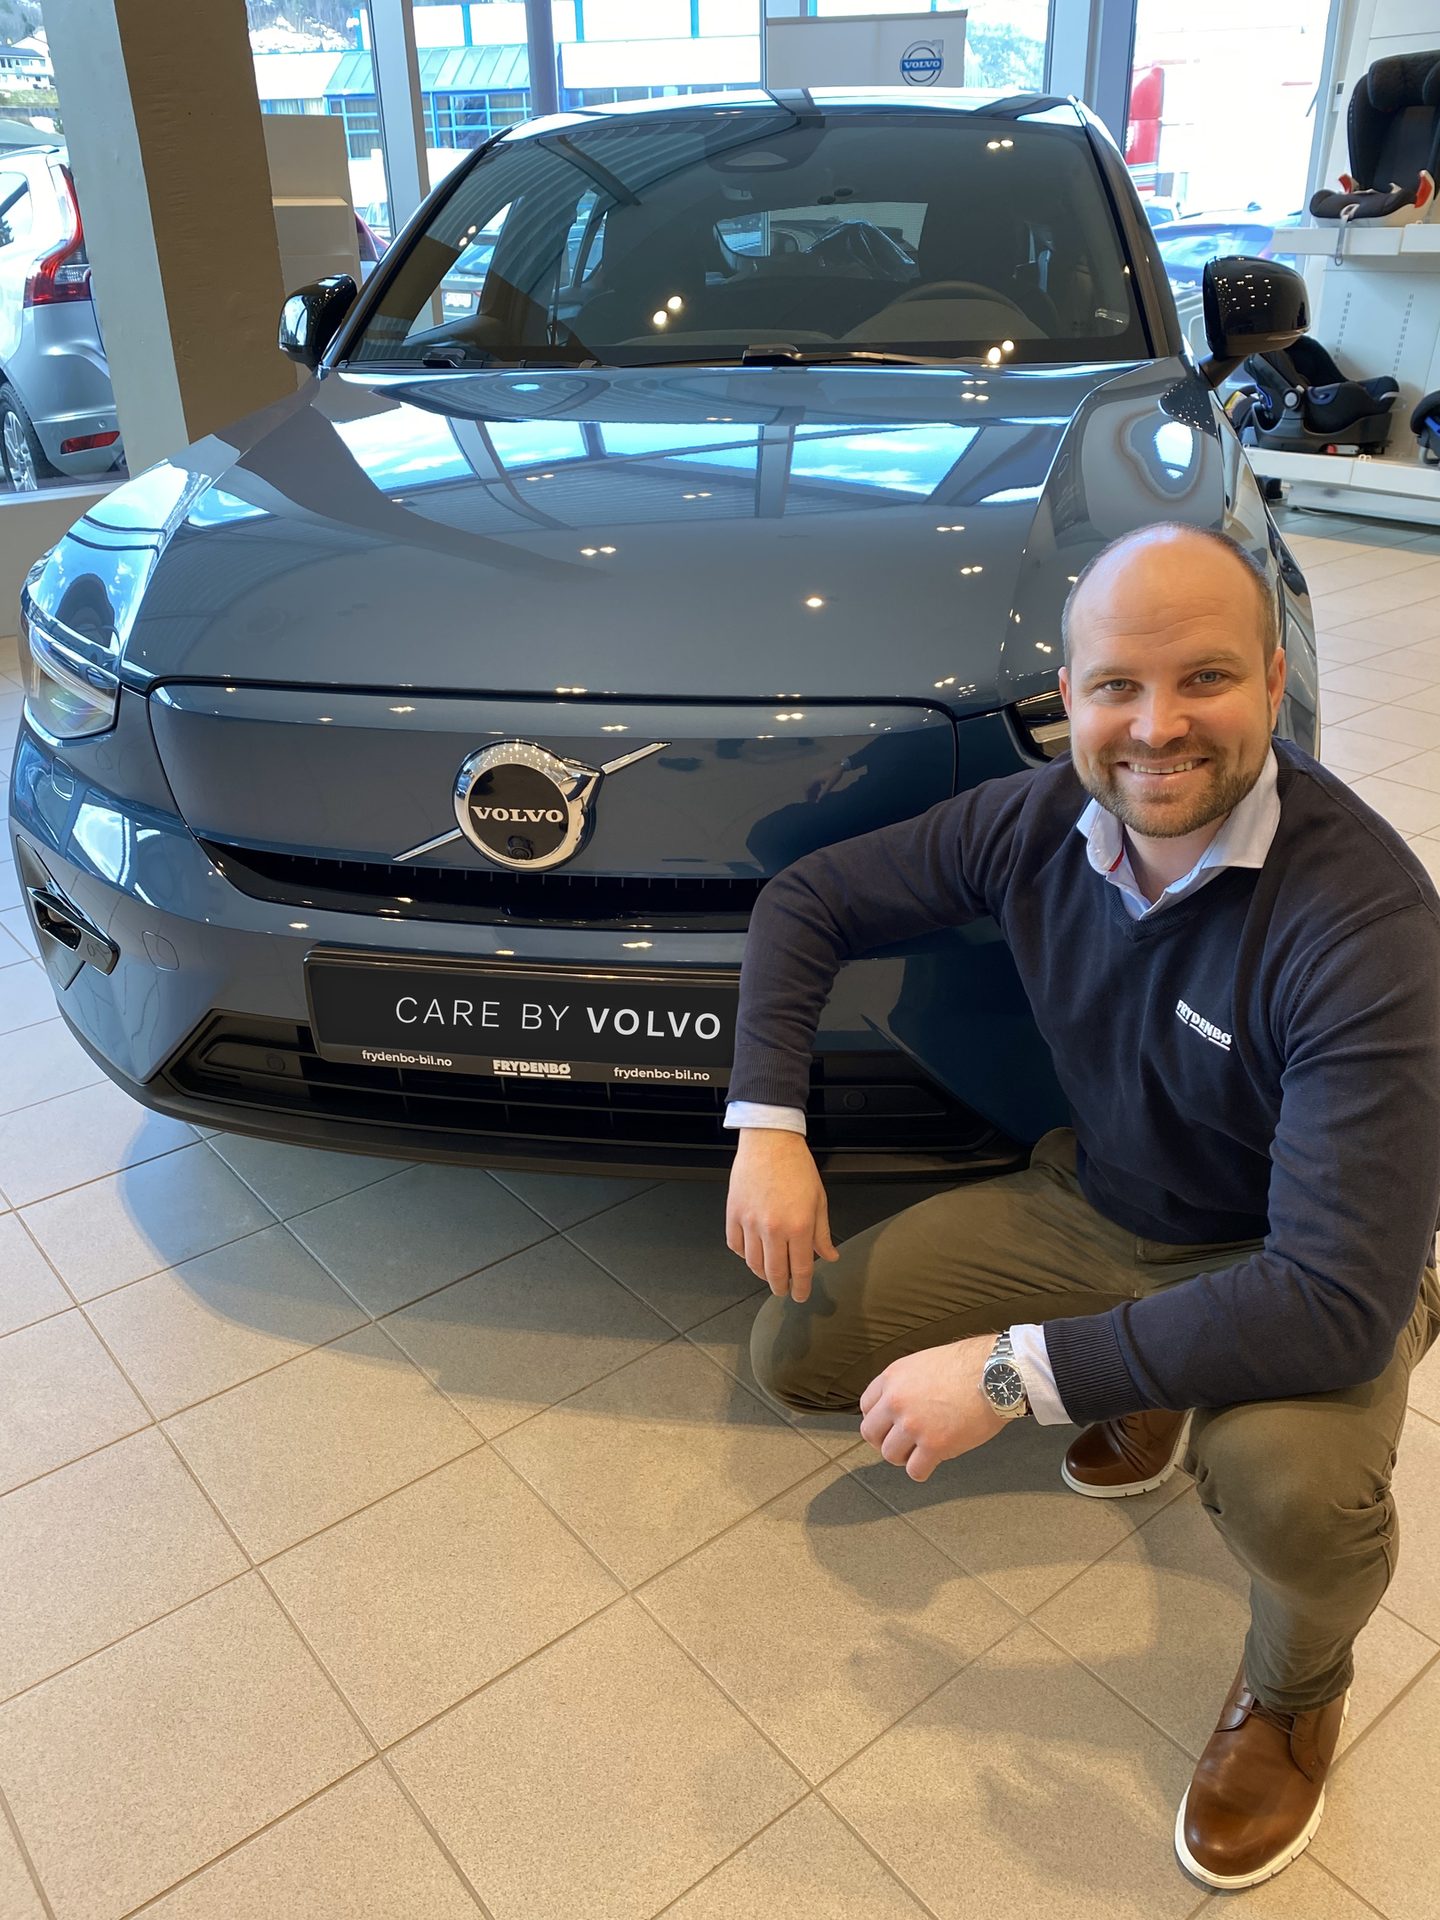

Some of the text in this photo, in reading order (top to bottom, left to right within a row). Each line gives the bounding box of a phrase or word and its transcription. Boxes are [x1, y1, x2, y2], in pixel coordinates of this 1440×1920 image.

[903, 60, 940, 69] VOLVO
[470, 805, 564, 822] VOLVO
[395, 996, 722, 1040] CARE BY VOLVO
[361, 1049, 710, 1081] frydenbo-bil.no FRYDENBØ frydenbo-bil.no
